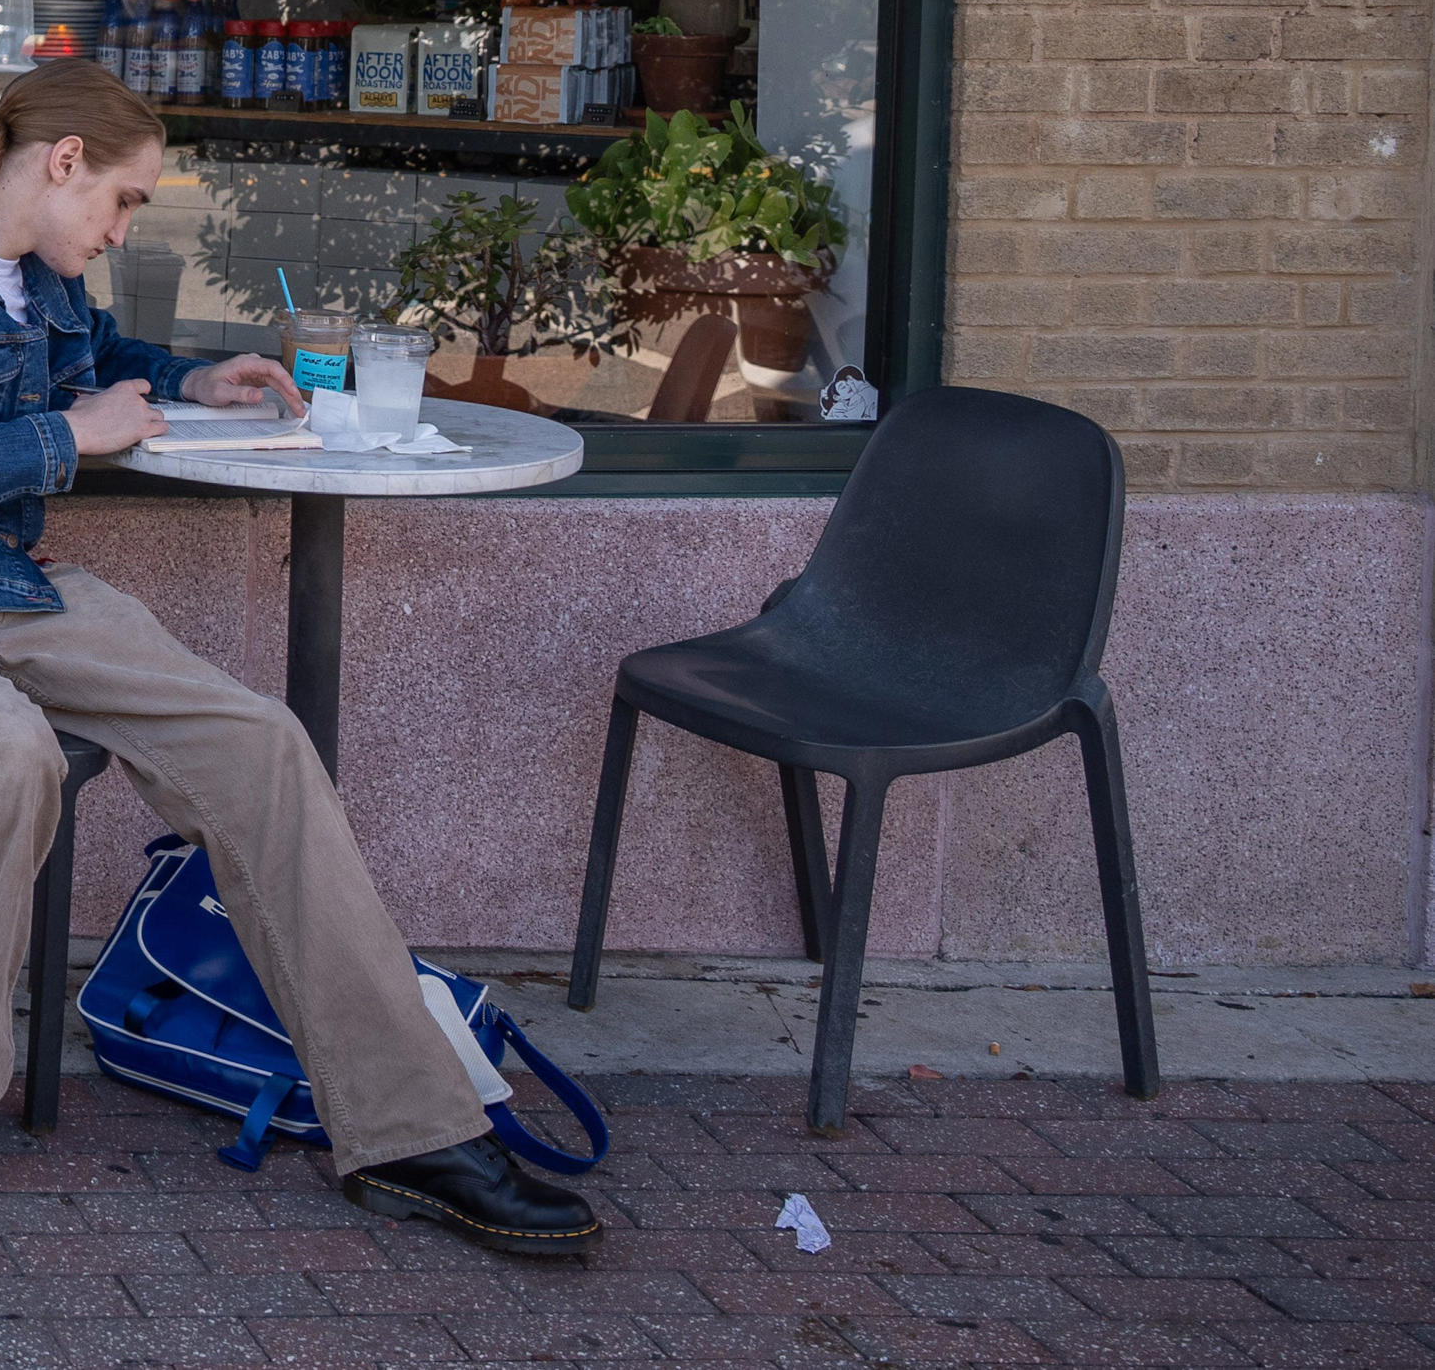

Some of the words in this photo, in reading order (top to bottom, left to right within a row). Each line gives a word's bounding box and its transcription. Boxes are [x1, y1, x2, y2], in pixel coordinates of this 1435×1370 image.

[508, 18, 527, 63] BA
[527, 16, 554, 64] ND
[356, 52, 404, 66] AFTER
[423, 54, 472, 67] AFTER
[355, 65, 404, 80] NOON
[423, 67, 473, 81] NOON
[355, 79, 403, 89] ROASTING
[423, 80, 472, 90] ROASTING
[363, 93, 393, 102] ALWAYS
[495, 76, 514, 120] BA
[514, 73, 541, 123] ND
[541, 79, 560, 118] IT
